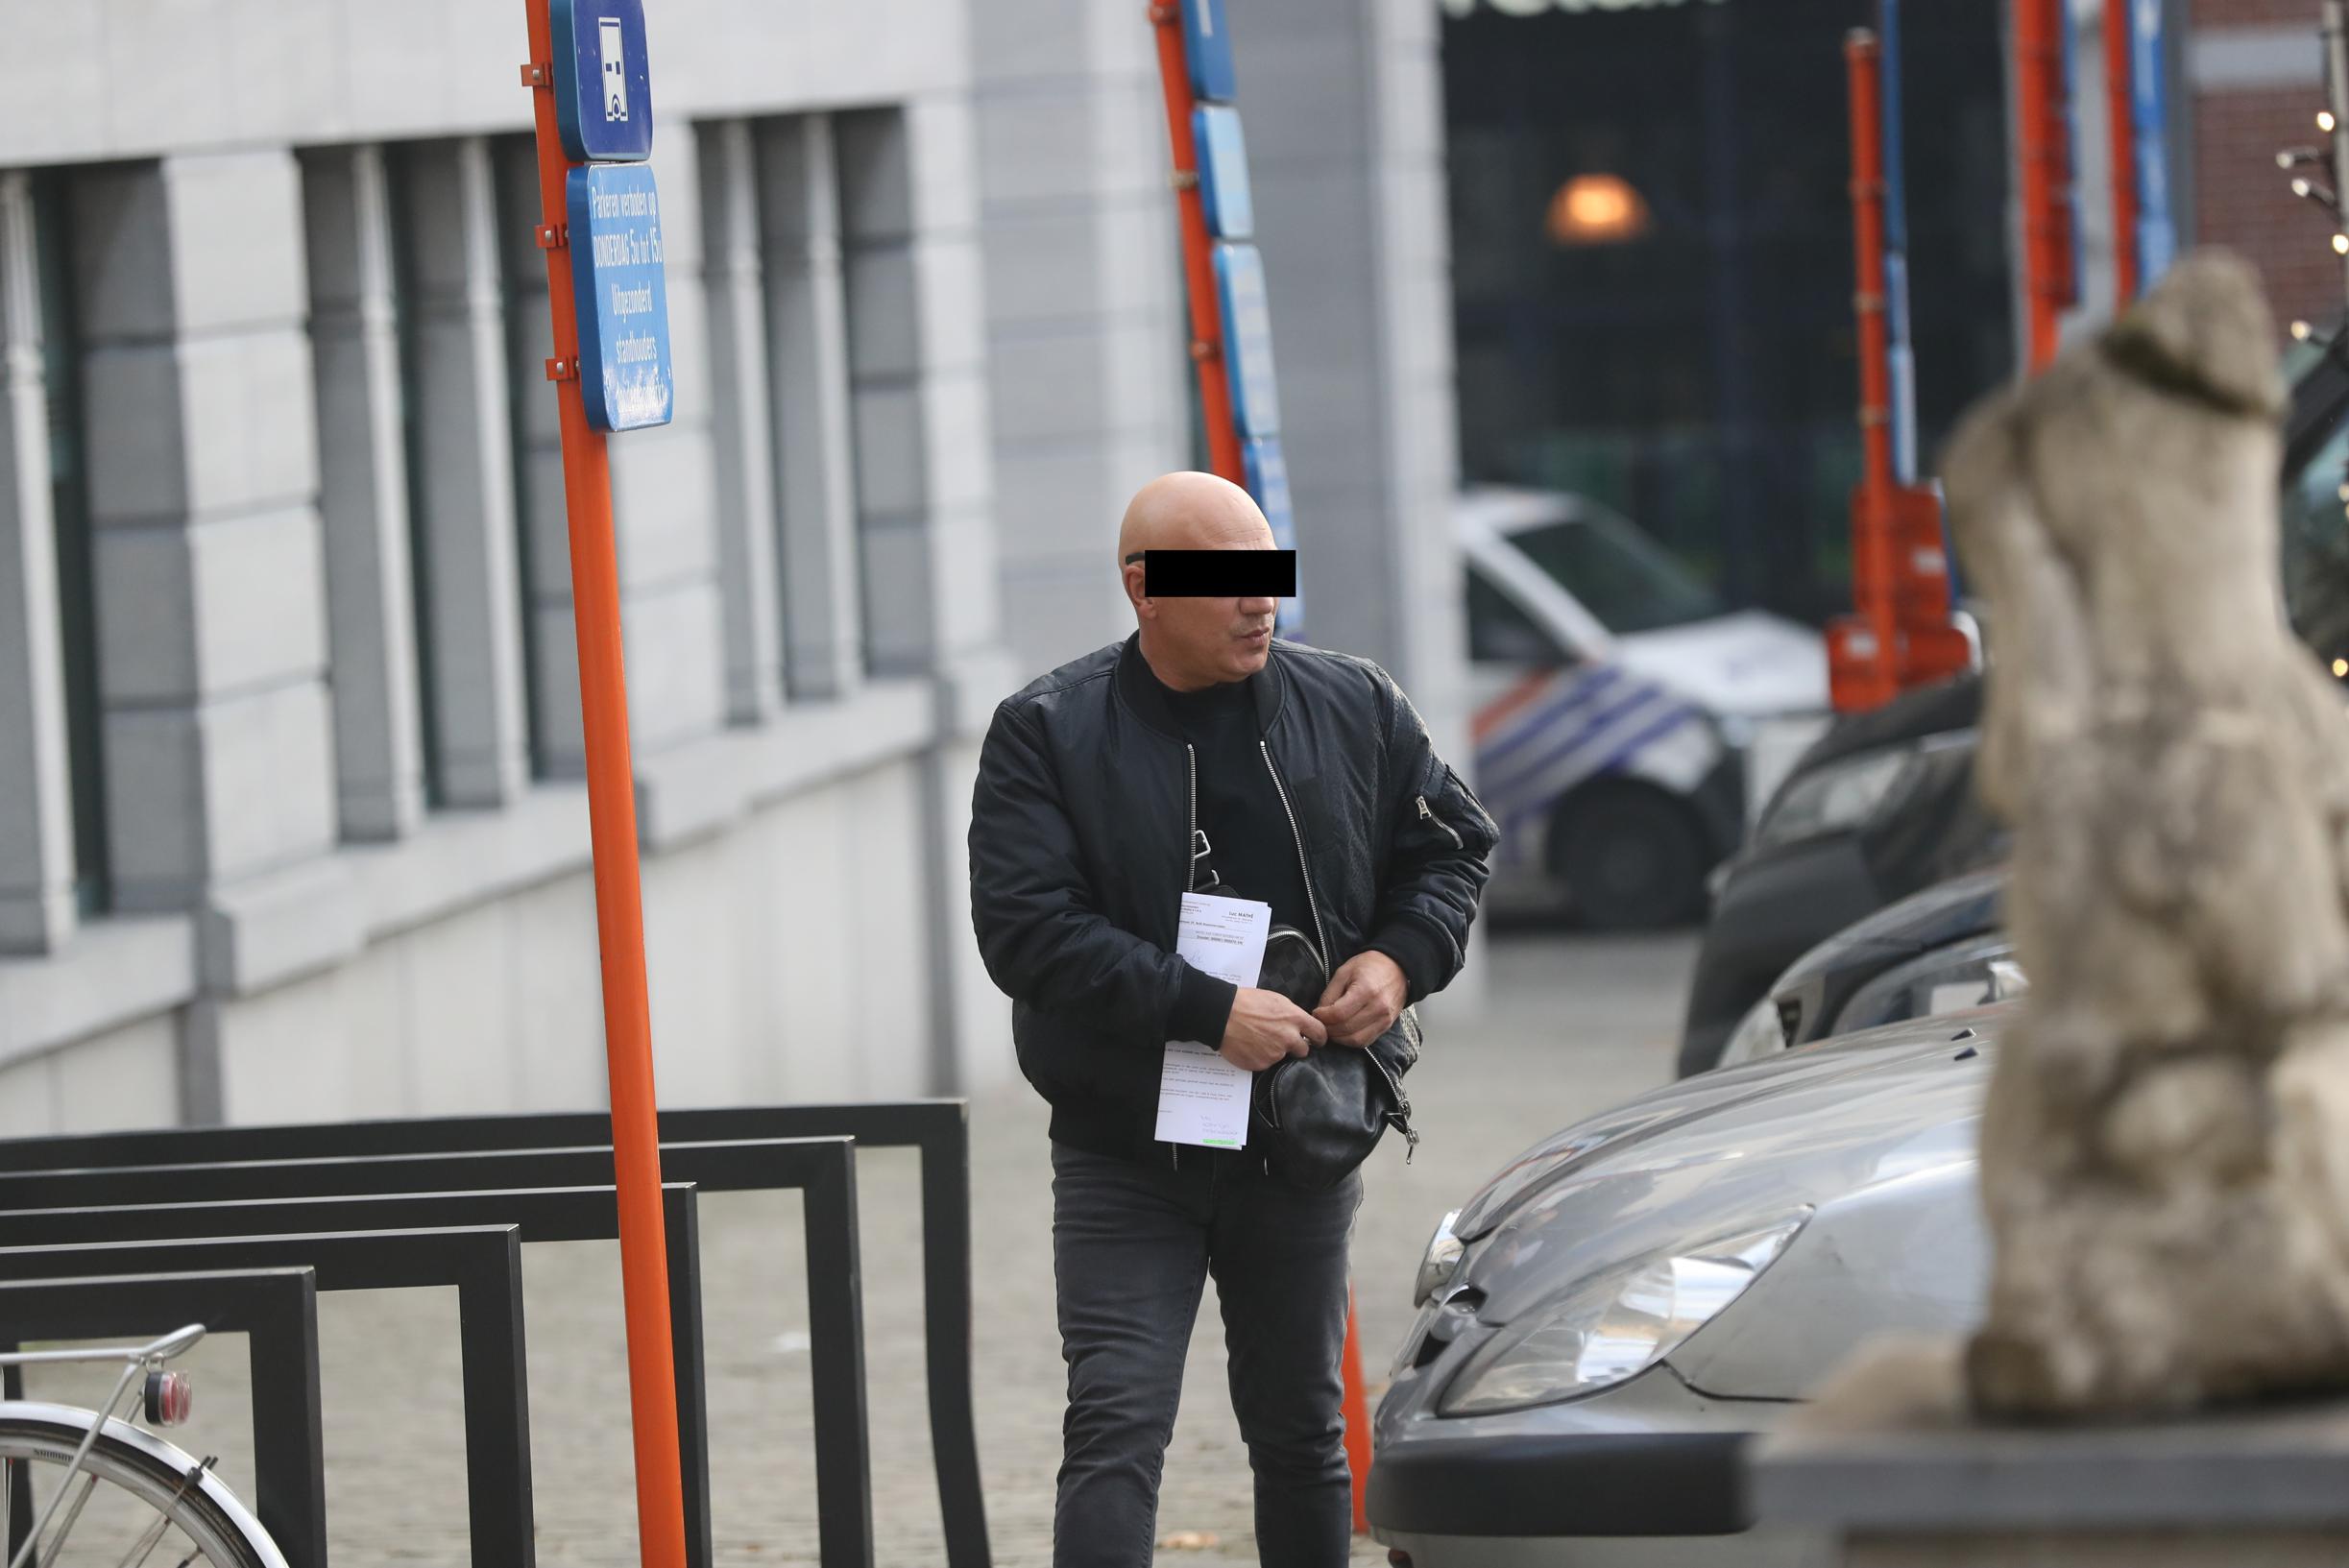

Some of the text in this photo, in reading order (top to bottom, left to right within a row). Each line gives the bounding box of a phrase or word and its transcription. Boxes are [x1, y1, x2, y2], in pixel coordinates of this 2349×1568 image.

[592, 183, 657, 224] Parkeren verboden op
[593, 227, 663, 268] DONDERDAG 5u tot 15u
[611, 279, 653, 324] Uitgezonderd
[616, 329, 657, 364] standhouders
